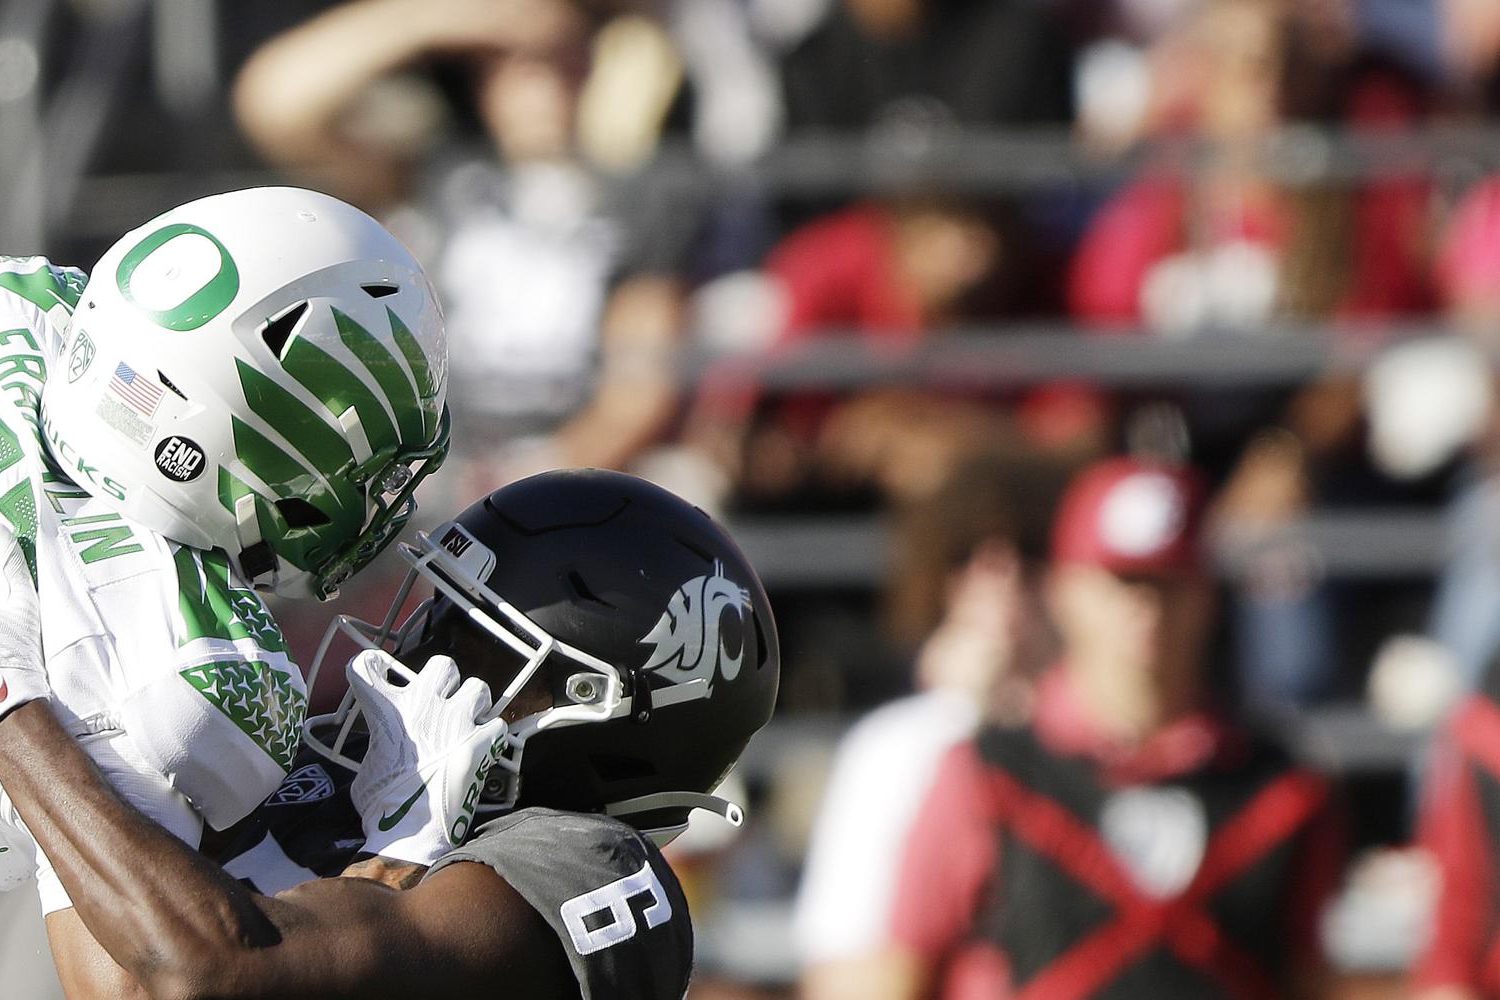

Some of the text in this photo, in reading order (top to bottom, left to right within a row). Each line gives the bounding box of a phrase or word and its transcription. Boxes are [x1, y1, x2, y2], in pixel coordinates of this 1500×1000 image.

[116, 223, 240, 331] O
[156, 453, 191, 480] RACISM
[162, 436, 203, 471] END
[560, 860, 673, 956] 6
